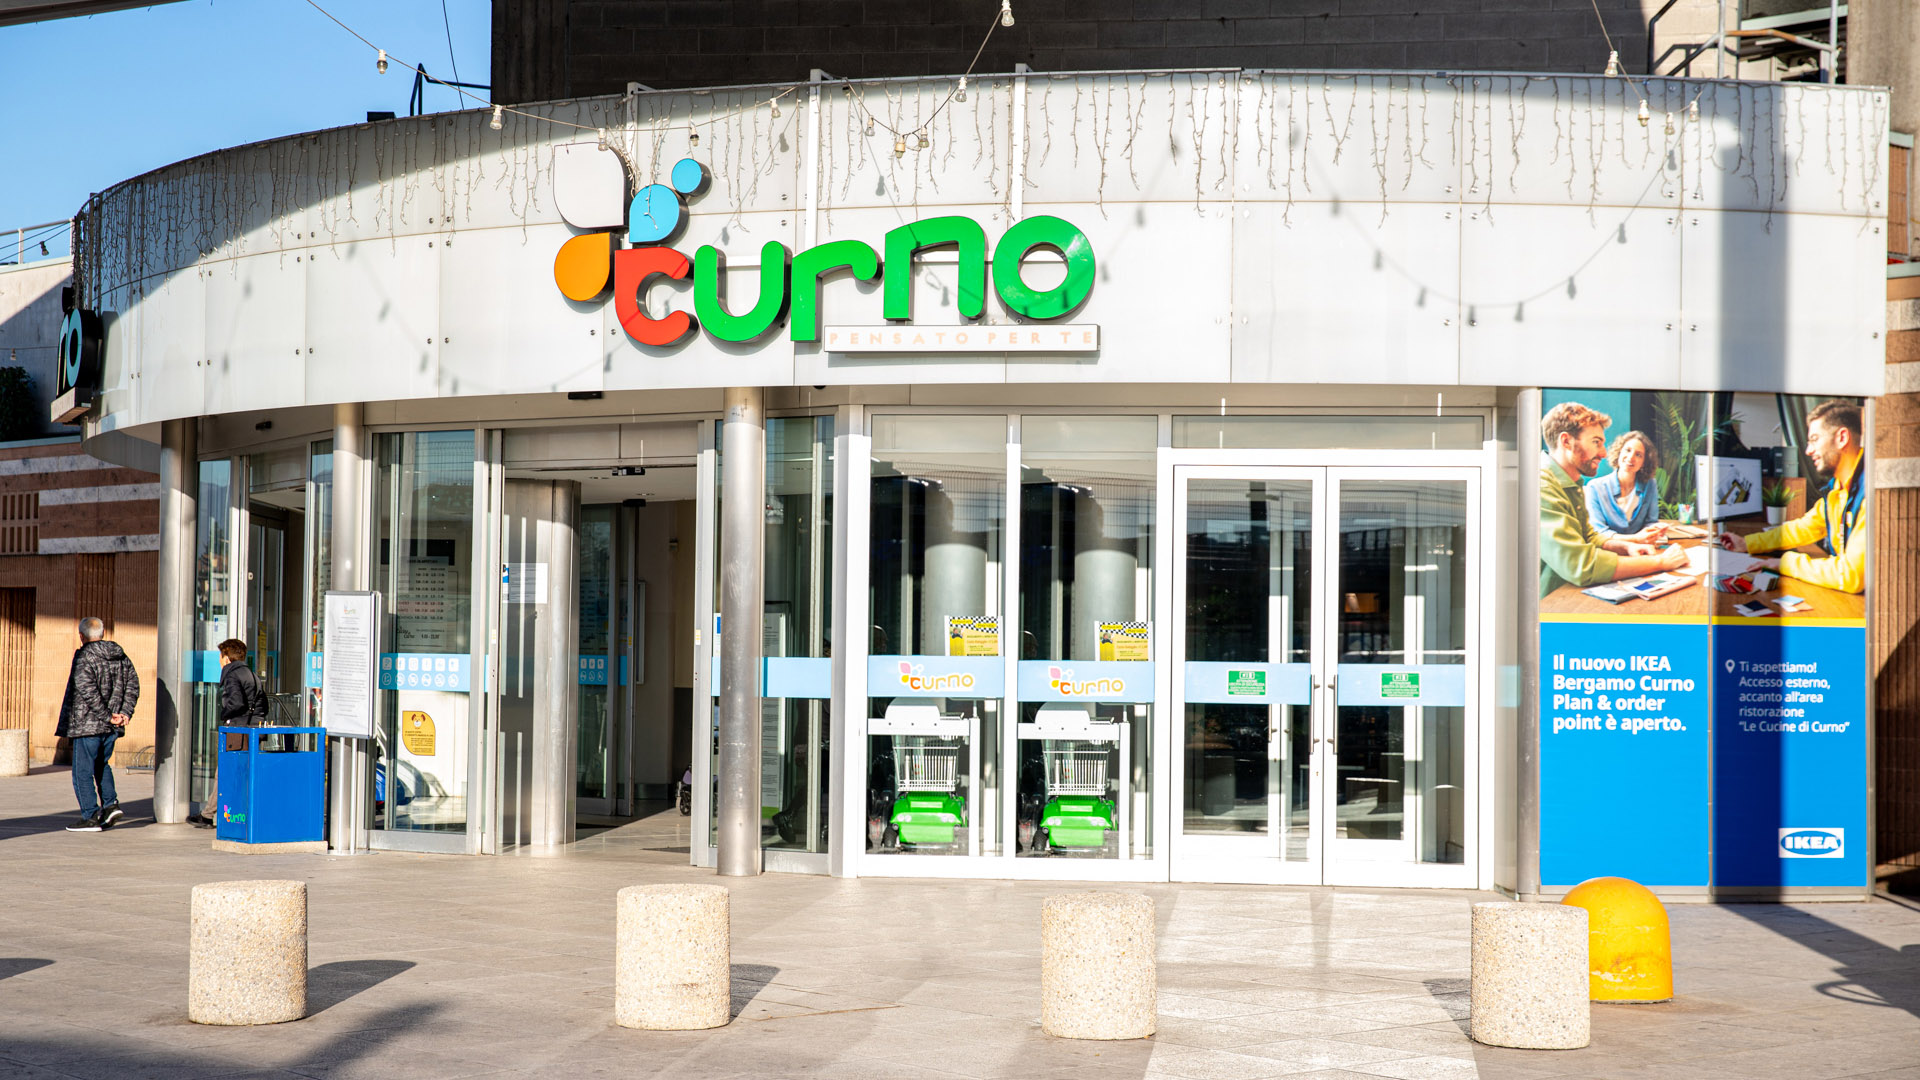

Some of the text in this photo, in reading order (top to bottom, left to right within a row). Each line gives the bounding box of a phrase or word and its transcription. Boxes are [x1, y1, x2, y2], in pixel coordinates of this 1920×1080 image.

[614, 215, 1096, 346] curno
[828, 330, 1093, 346] PENSATO PER TE
[1553, 653, 1672, 671] Il nuovo IKEA
[1739, 661, 1817, 676] Ti aspettiamo!
[909, 673, 974, 691] curno
[1059, 678, 1124, 696] curno
[1553, 674, 1695, 695] Bergamo Curno
[1739, 676, 1831, 690] Accesso esterno,
[1553, 693, 1666, 711] Plan & order
[1739, 692, 1783, 703] accanto
[1739, 706, 1805, 718] ristorazione
[1553, 713, 1687, 736] point è aperto.
[1758, 720, 1797, 733] Cucine
[1798, 720, 1809, 733] di
[1784, 836, 1840, 850] IKEA
